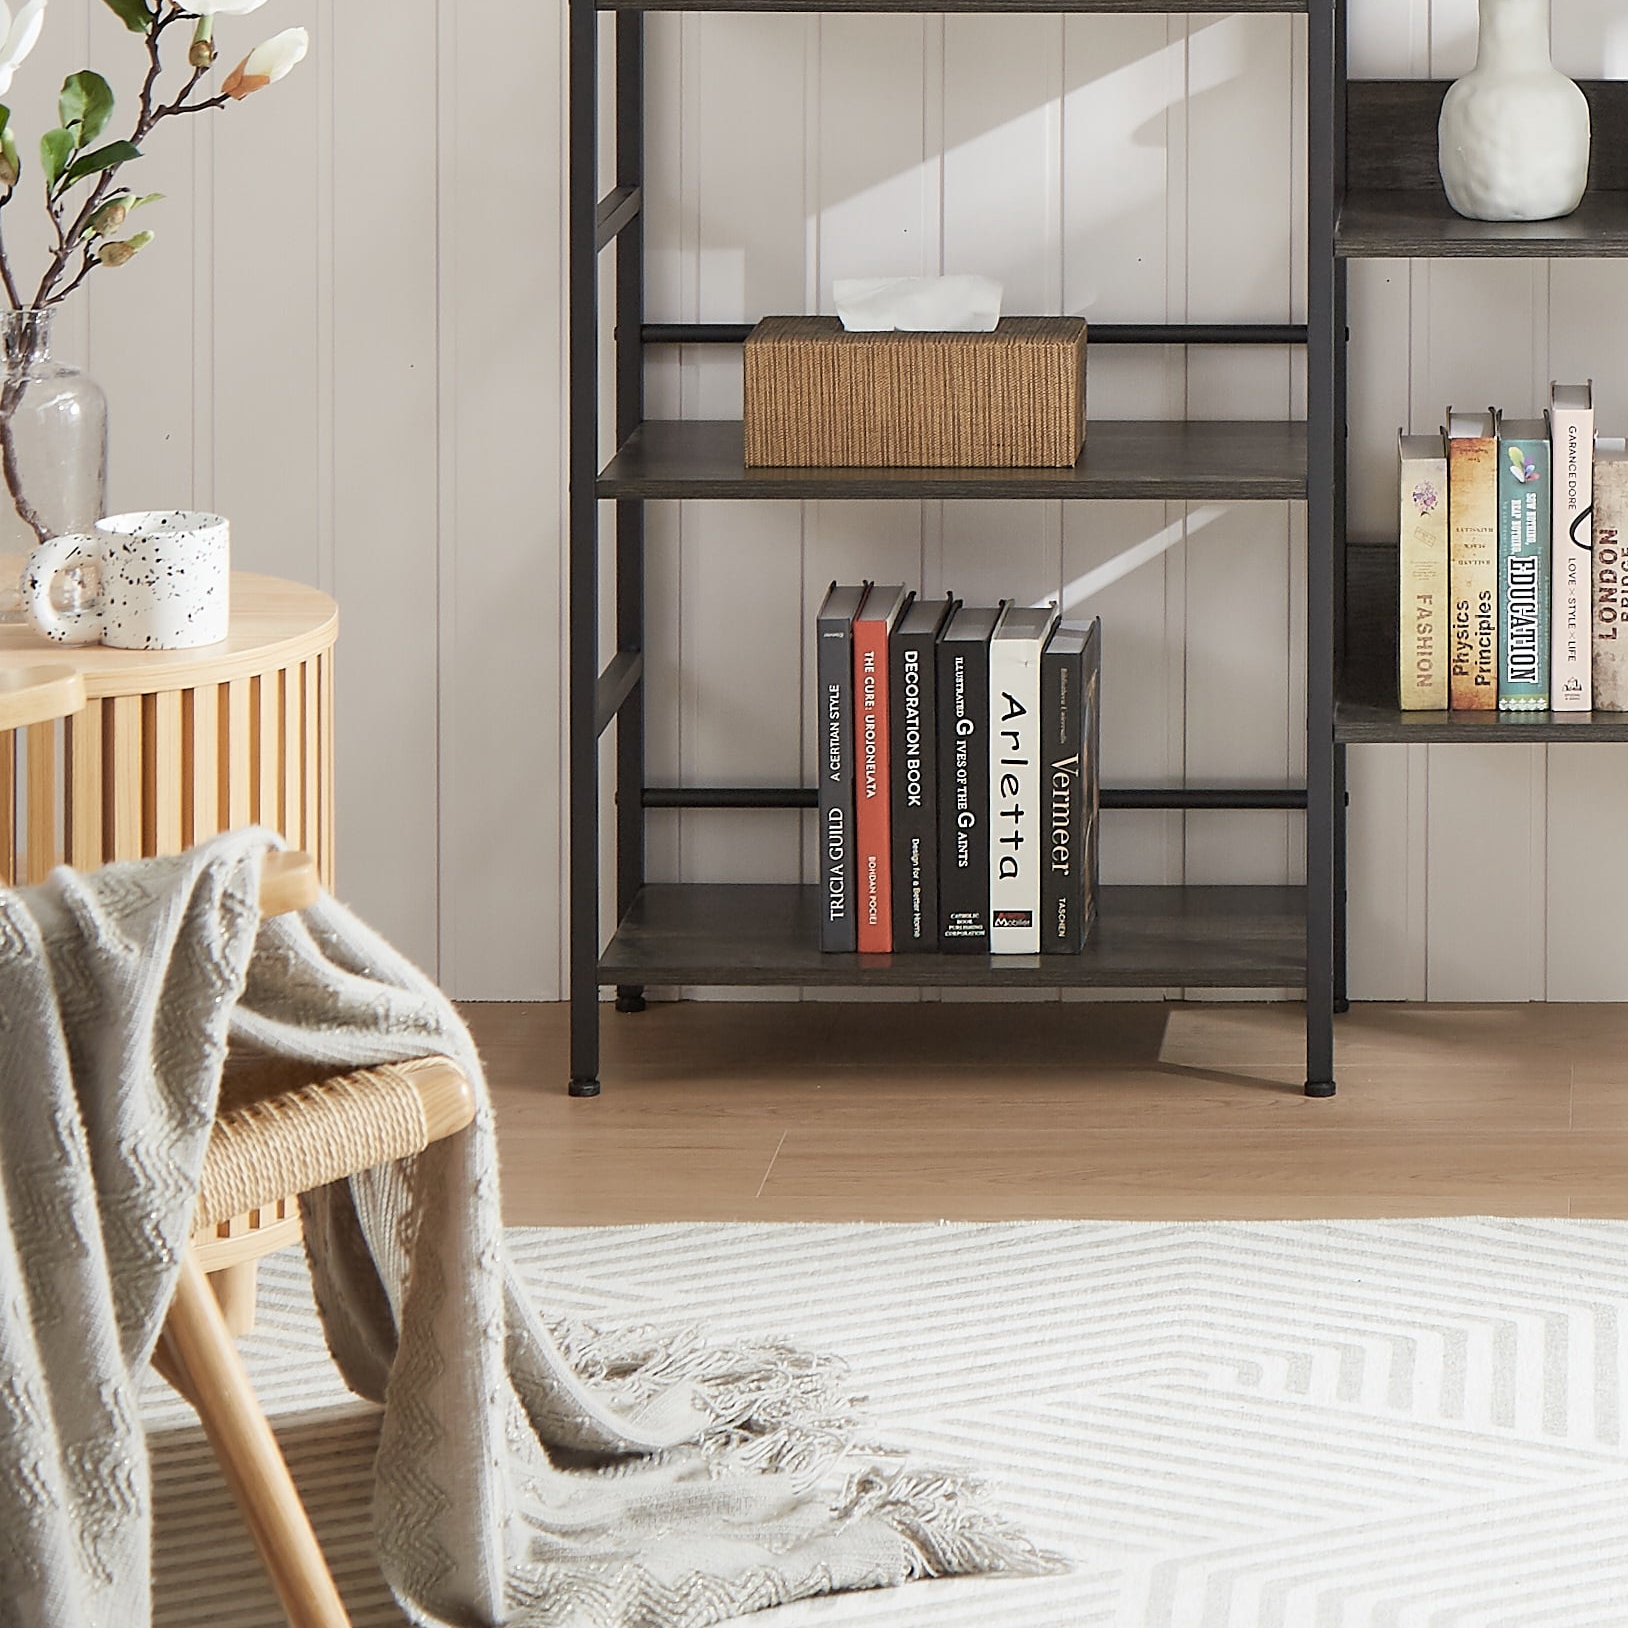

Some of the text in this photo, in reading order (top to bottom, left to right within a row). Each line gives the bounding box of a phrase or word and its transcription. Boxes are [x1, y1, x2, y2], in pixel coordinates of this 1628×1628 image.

[1567, 425, 1577, 511] GARANCE DORE
[1567, 557, 1577, 586] LOVE
[1598, 529, 1618, 640] LONDON
[1452, 600, 1474, 676] Physics
[1474, 590, 1496, 686] Principles
[1508, 557, 1537, 682] EDUCATION
[1567, 597, 1577, 630] STYLE
[864, 650, 875, 673] THE
[1416, 594, 1433, 688] FASHION
[1567, 640, 1577, 662] LIFE
[864, 676, 875, 711] CURE:
[954, 656, 965, 718] ILLUSTRATED
[829, 684, 841, 782] A CERTIAN STYLE
[904, 651, 921, 807] DECORATION BOOK
[956, 768, 967, 784] OF
[956, 785, 968, 810] THE
[999, 692, 1029, 880] Arletta
[1050, 752, 1080, 877] Vermeer
[828, 807, 845, 922] TRICIA GUILD
[868, 856, 877, 894] BOHDAN
[911, 838, 921, 866] Design
[912, 867, 921, 879] for
[913, 913, 921, 938] Home
[1057, 897, 1067, 938] TASCHEN
